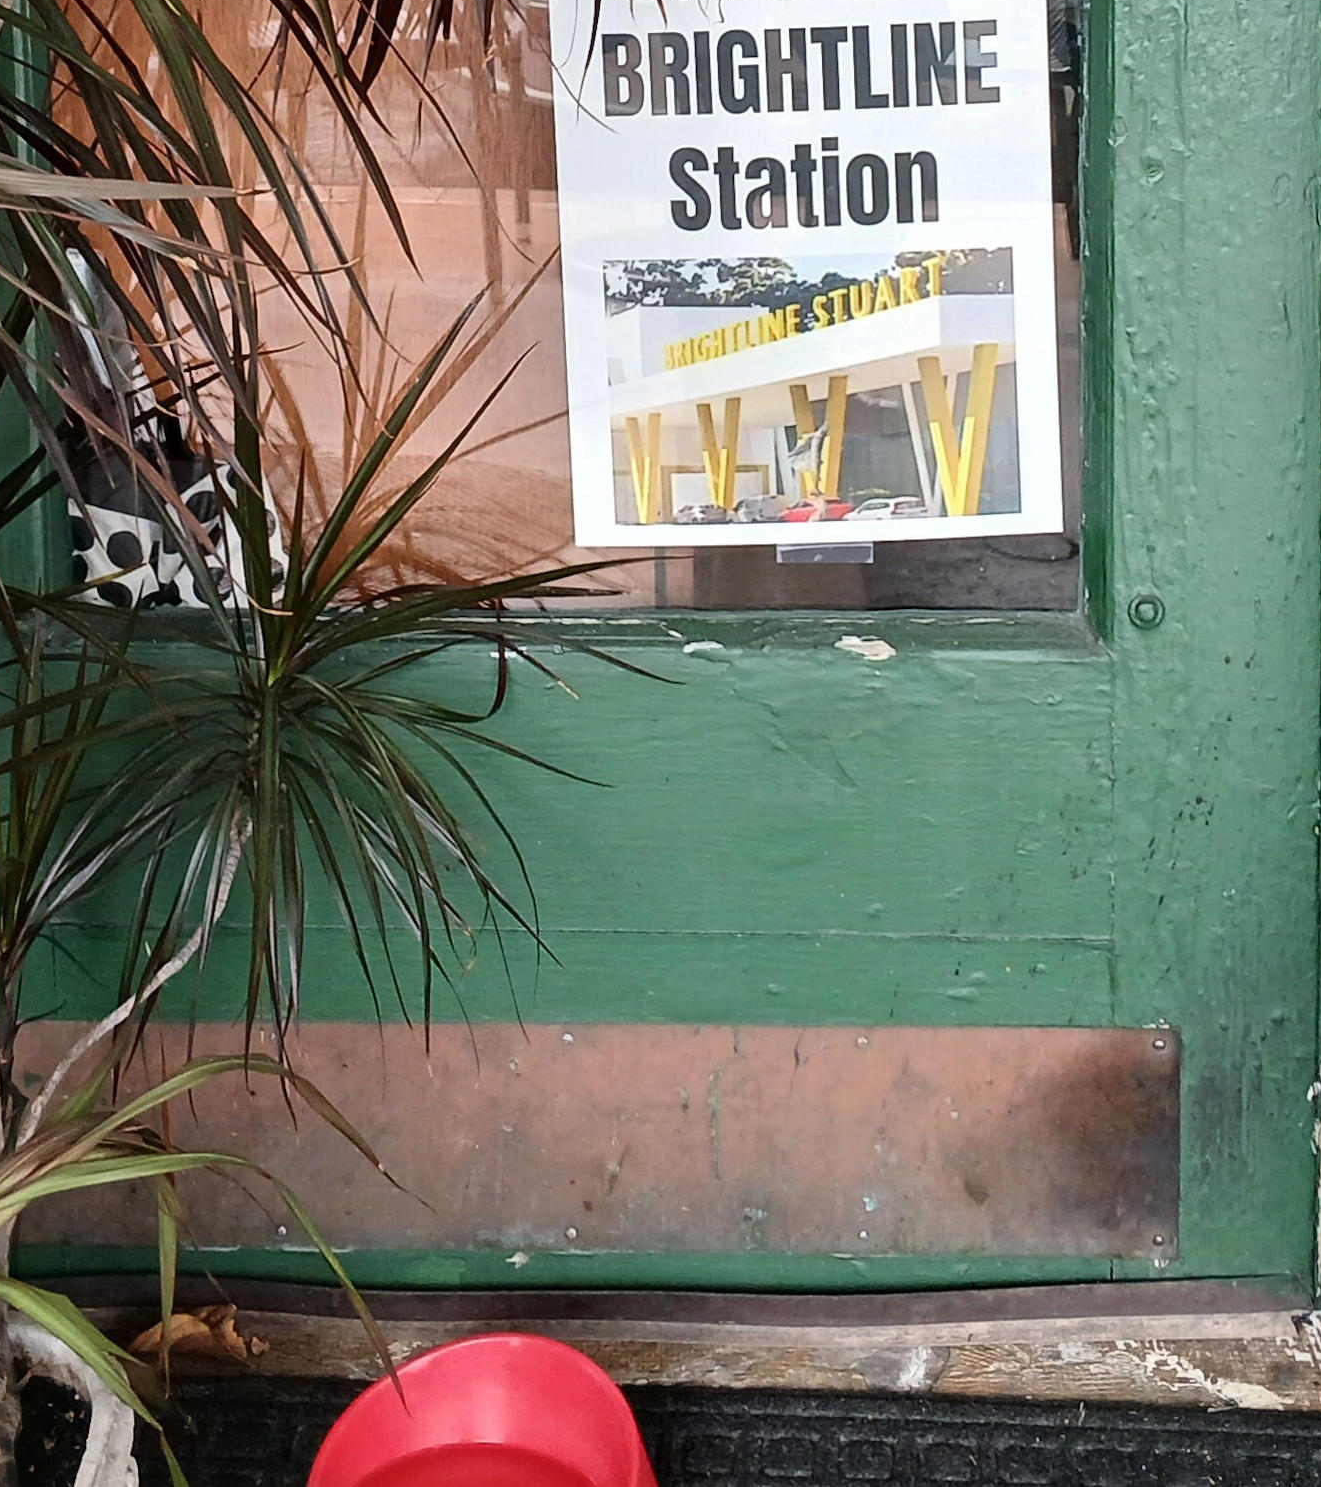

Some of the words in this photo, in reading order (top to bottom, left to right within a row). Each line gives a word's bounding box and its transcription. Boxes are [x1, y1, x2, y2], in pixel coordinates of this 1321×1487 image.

[600, 19, 1001, 118] BRIGHTLINE
[668, 136, 940, 232] Station
[663, 303, 801, 372] BRIGHTLINE
[812, 255, 944, 329] STUART
